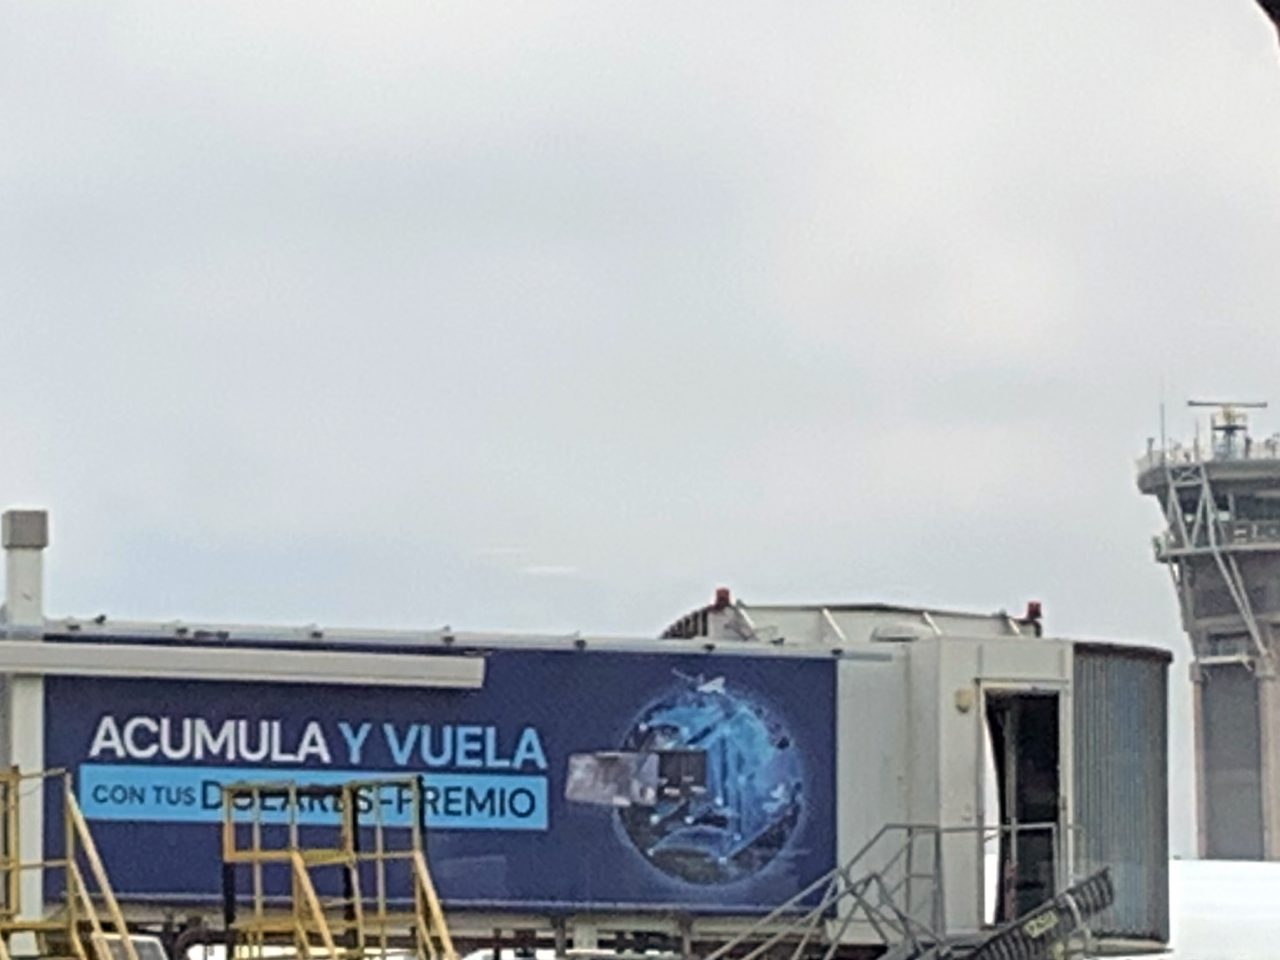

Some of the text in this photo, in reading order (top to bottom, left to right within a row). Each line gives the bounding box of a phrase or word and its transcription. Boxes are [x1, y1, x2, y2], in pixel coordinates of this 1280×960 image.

[89, 715, 548, 770] ACUMULA Y VUELA
[92, 783, 146, 804] CON
[152, 784, 197, 807] TUS
